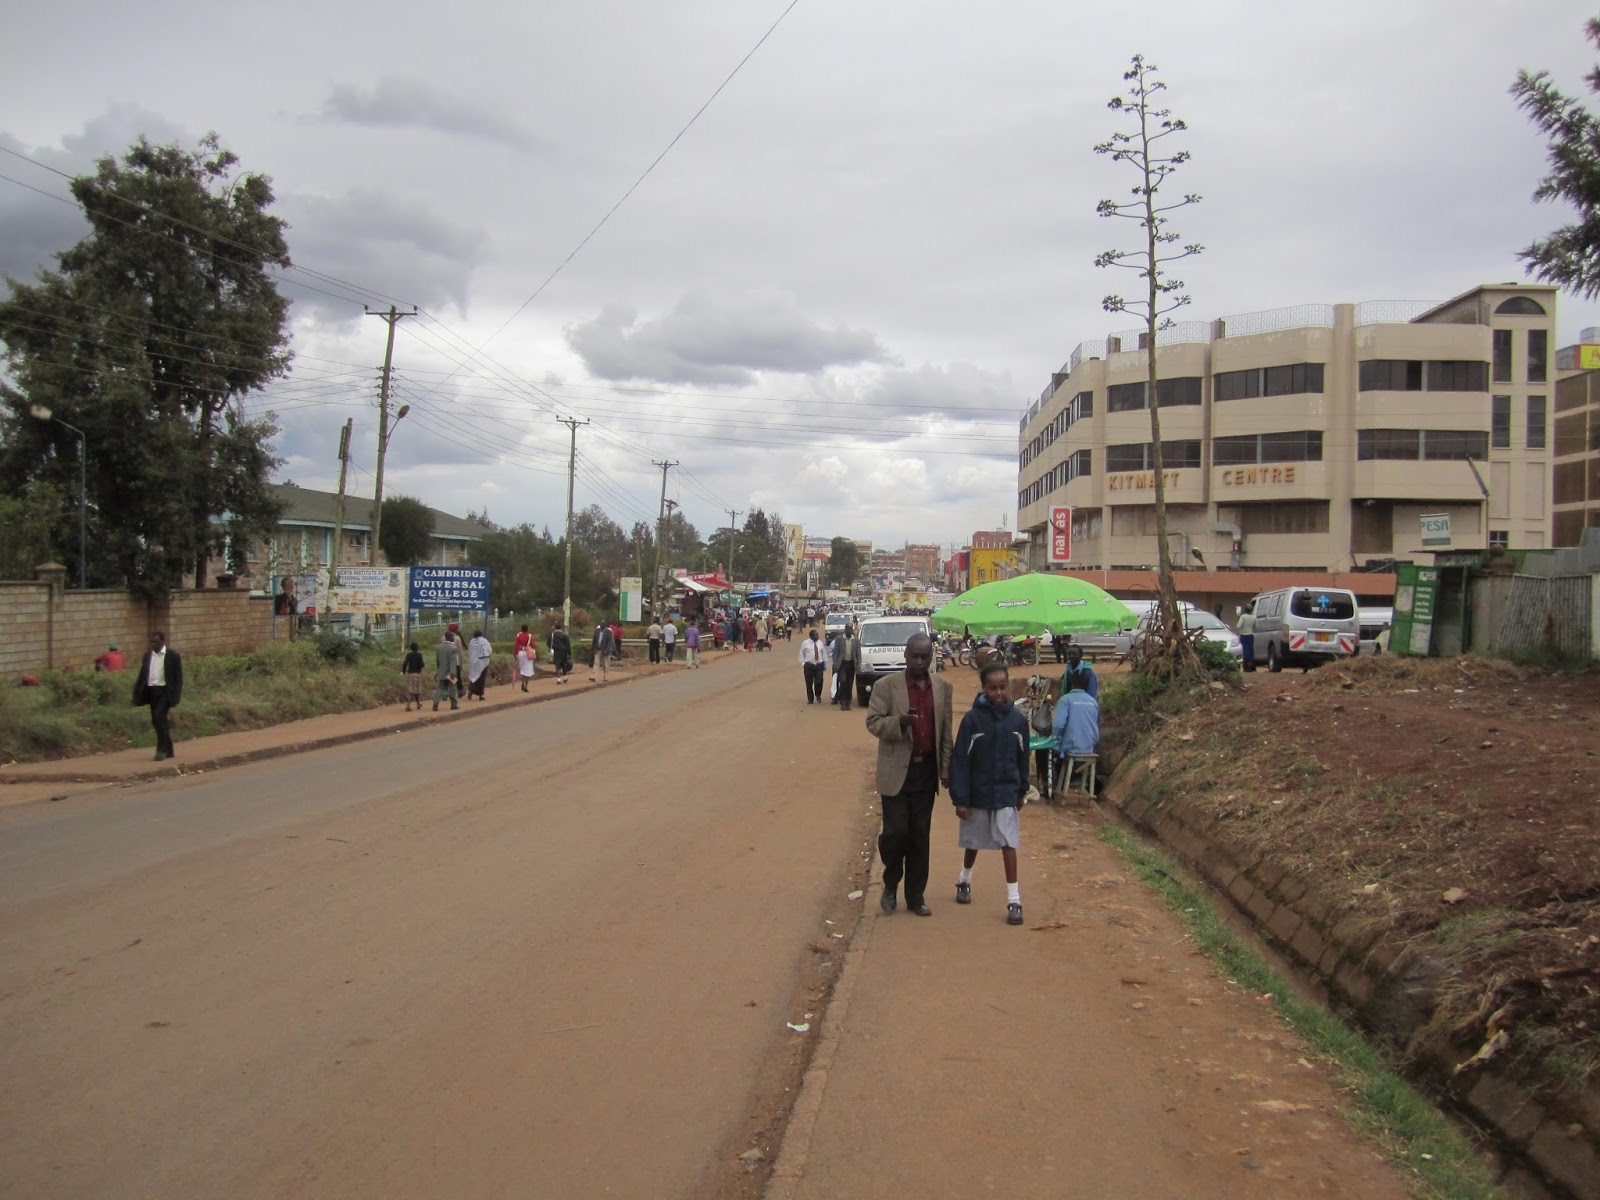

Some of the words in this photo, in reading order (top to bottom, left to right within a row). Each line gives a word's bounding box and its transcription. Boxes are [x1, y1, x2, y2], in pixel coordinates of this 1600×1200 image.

[1221, 466, 1295, 486] CENTRE
[1051, 512, 1066, 555] naivas
[423, 569, 486, 578] CAMBRIDGE
[414, 580, 485, 589] UNIVERSAL
[420, 590, 478, 598] COLLEGE
